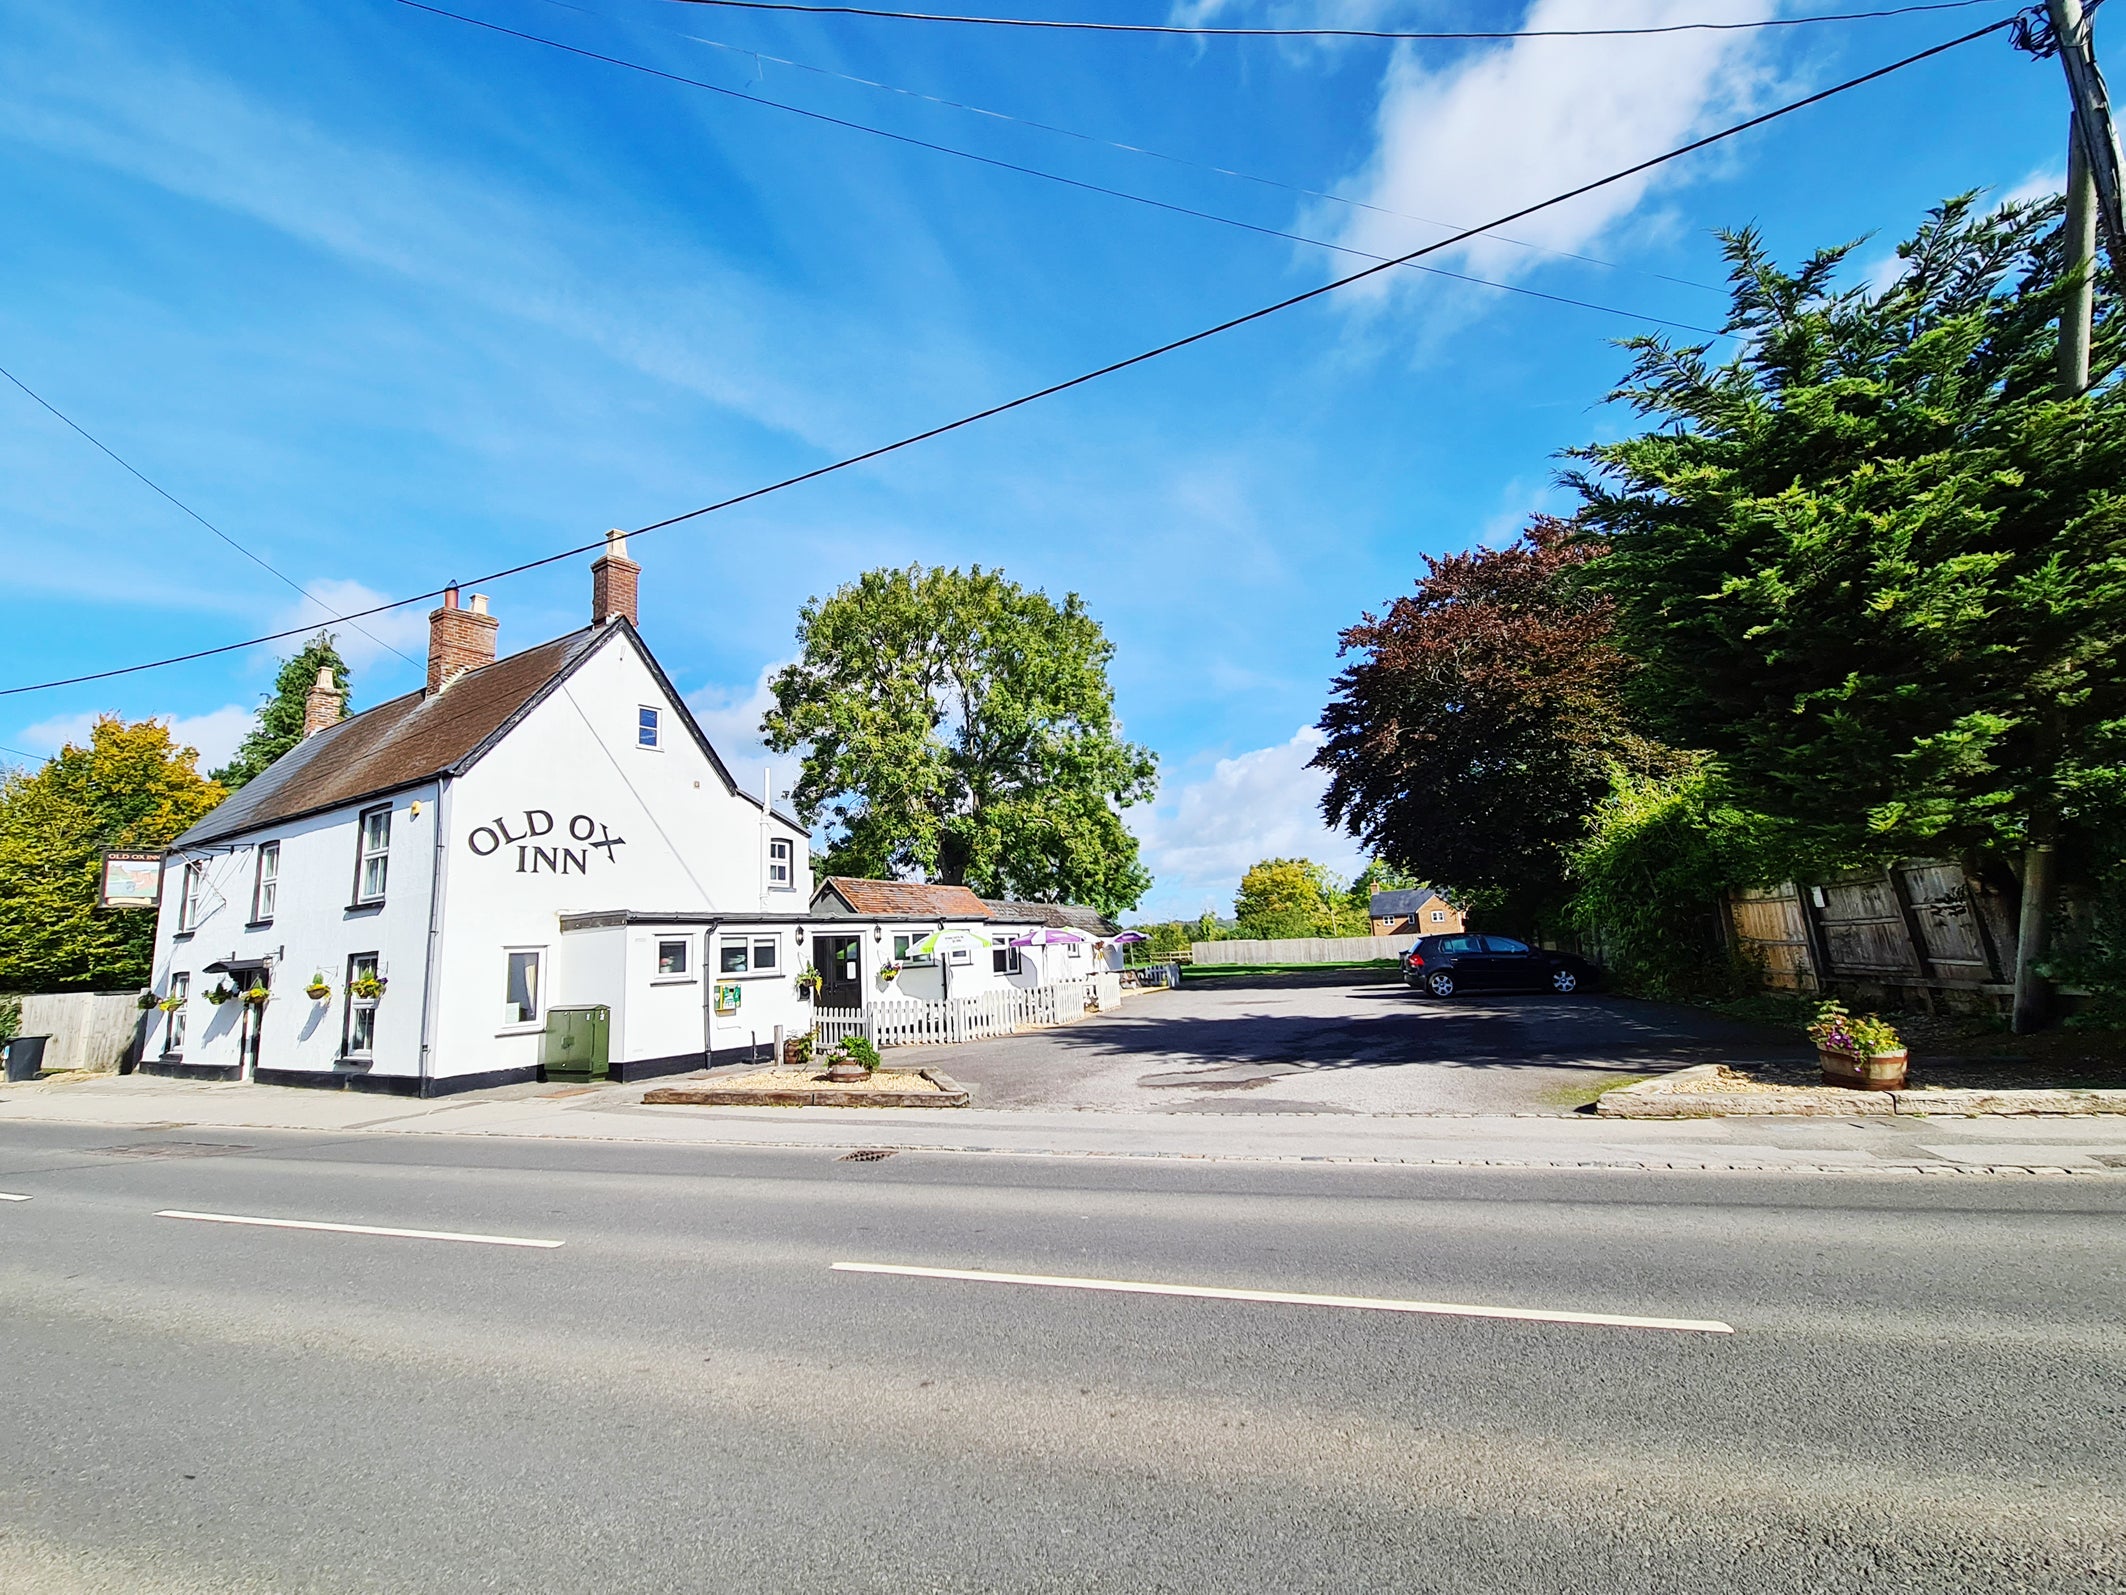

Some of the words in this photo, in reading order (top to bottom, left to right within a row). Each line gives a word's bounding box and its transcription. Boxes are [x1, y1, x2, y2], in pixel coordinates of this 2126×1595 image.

[468, 809, 554, 857] OLD
[569, 814, 627, 864] OX
[515, 845, 588, 875] INN
